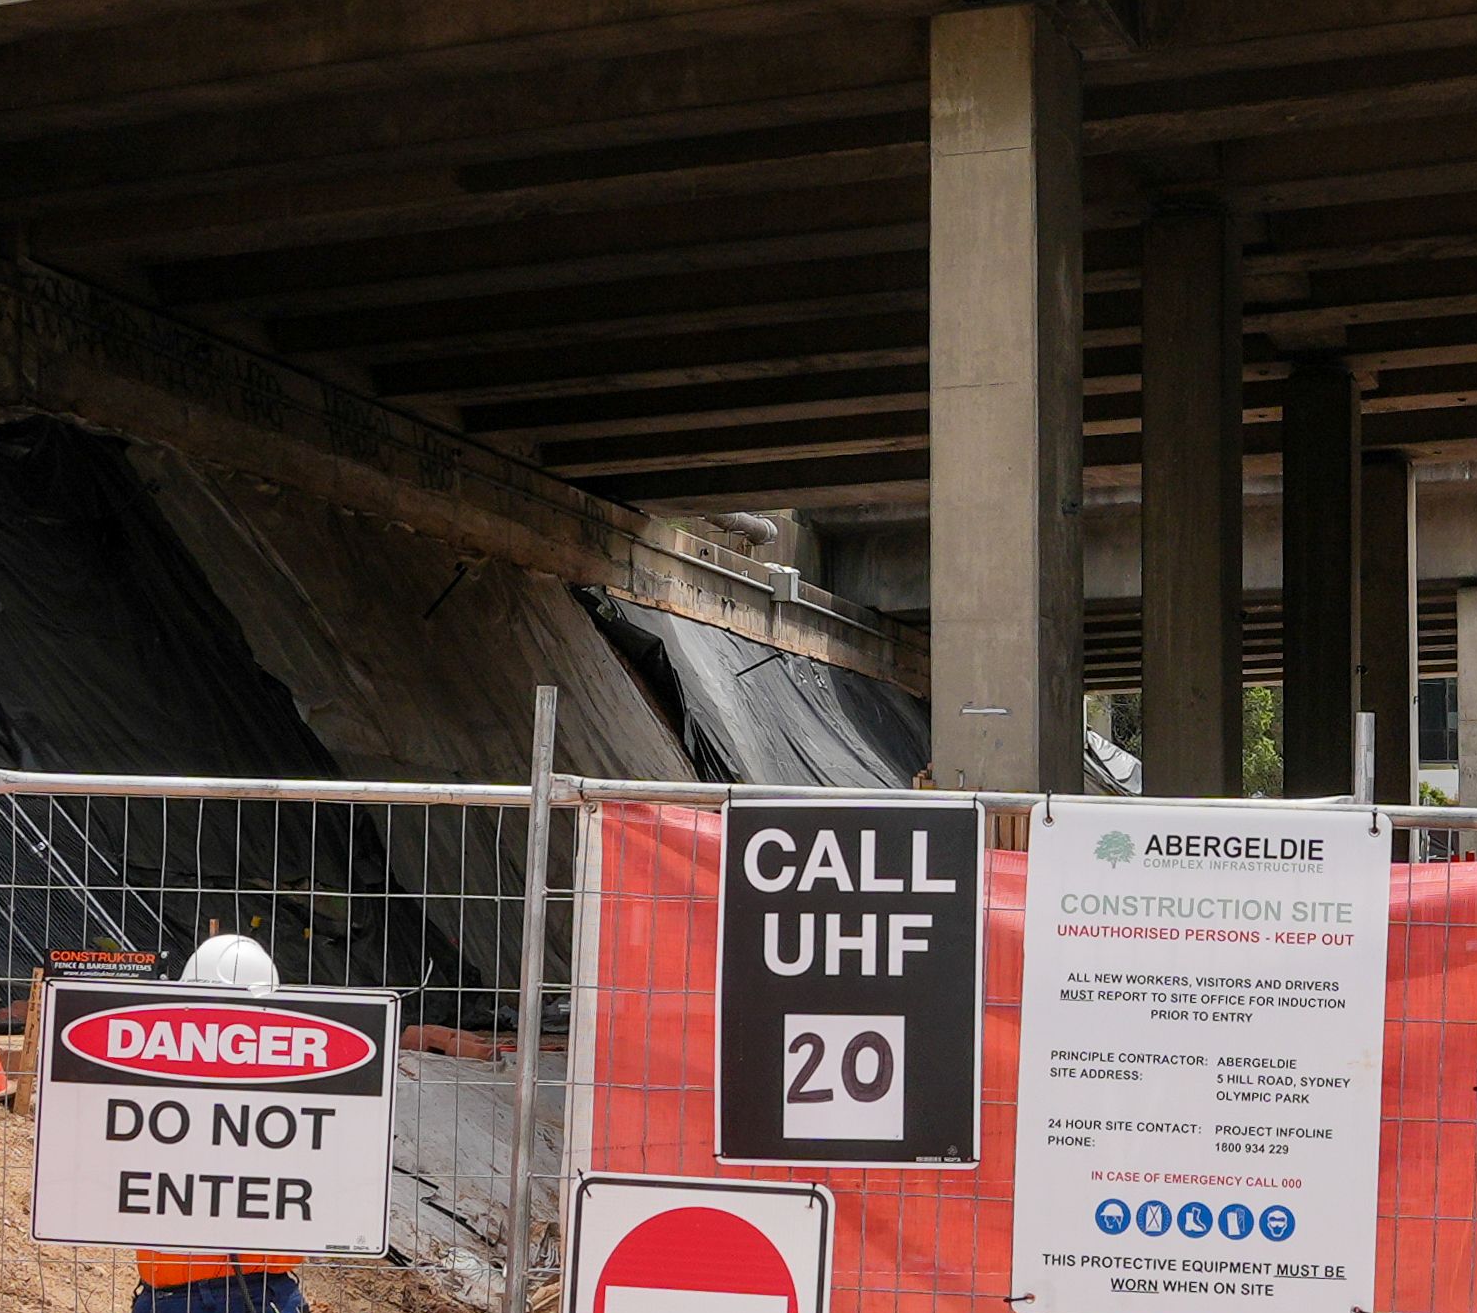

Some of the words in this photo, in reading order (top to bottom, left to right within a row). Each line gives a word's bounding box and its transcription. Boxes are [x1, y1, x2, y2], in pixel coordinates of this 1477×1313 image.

[1145, 834, 1324, 861] ABERGELDIE
[743, 828, 957, 894] CALL
[1144, 858, 1203, 870] COMPLEX
[1209, 860, 1324, 873] INFRASTRUCTURE
[1060, 894, 1281, 921] CONSTRUCTION
[1292, 901, 1353, 923] SITE
[762, 912, 933, 977] UHF
[1057, 925, 1180, 940] UNAUTHORISED
[1185, 929, 1260, 944] PERSONS
[1275, 932, 1317, 945] KEEP
[1322, 933, 1354, 946] OUT
[50, 951, 155, 964] CONSTRUKTOR
[119, 963, 152, 971] SYSTEMS
[1067, 973, 1090, 983] ALL
[1094, 974, 1123, 984] NEW
[1126, 975, 1192, 988] WORKERS,
[1196, 976, 1251, 989] VISITORS
[1255, 979, 1281, 990] AND
[1285, 980, 1339, 991] DRIVERS
[1060, 990, 1094, 1002] MUST
[1097, 991, 1147, 1002] REPORT
[1151, 993, 1167, 1003] TO
[1170, 993, 1197, 1004] SITE
[1201, 994, 1246, 1006] OFFICE
[1250, 996, 1275, 1007] FOR
[1278, 997, 1346, 1009] INDUCTION
[1150, 1010, 1189, 1021] PRIOR
[1193, 1011, 1208, 1021] TO
[1212, 1012, 1253, 1023] ENTRY
[106, 1018, 328, 1068] DANGER
[785, 1031, 896, 1104] 20
[1050, 1050, 1115, 1063] PRINCIPLE
[1118, 1052, 1208, 1066] CONTRACTOR:
[1217, 1057, 1297, 1069] ABERGELDIE
[1050, 1067, 1075, 1078] SITE
[1078, 1068, 1143, 1081] ADDRESS:
[1217, 1074, 1223, 1084] 5
[1227, 1074, 1254, 1085] HILL
[1258, 1076, 1296, 1088] ROAD,
[1300, 1077, 1351, 1089] SYDNEY
[1216, 1091, 1272, 1103] OLYMPIC
[1275, 1092, 1310, 1104] PARK
[106, 1100, 190, 1144] DO
[212, 1104, 336, 1150] NOT
[1048, 1119, 1062, 1129] 24
[1065, 1120, 1102, 1131] HOUR
[1105, 1121, 1133, 1132] SITE
[1136, 1121, 1202, 1134] CONTACT:
[1215, 1125, 1273, 1137] PROJECT
[1276, 1126, 1333, 1139] INFOLINE
[1048, 1136, 1096, 1147] PHONE:
[1215, 1142, 1243, 1153] 1800
[1245, 1143, 1266, 1154] 934
[1268, 1144, 1289, 1155] 229
[1091, 1171, 1103, 1181] IN
[1106, 1171, 1140, 1183] CASE
[1144, 1172, 1161, 1183] OF
[1164, 1173, 1242, 1186] EMERGENCY
[1245, 1176, 1278, 1188] CALL
[1281, 1178, 1302, 1188] 000
[118, 1172, 313, 1221] ENTER
[1042, 1254, 1076, 1267] THIS
[1081, 1255, 1177, 1271] PROTECTIVE
[1182, 1259, 1271, 1275] EQUIPMENT
[1276, 1264, 1319, 1279] MUST
[1323, 1265, 1346, 1280] BE
[1111, 1278, 1159, 1294] WORN
[1163, 1280, 1210, 1294] WHEN
[1213, 1282, 1236, 1295] ON
[1240, 1283, 1274, 1297] SITE
